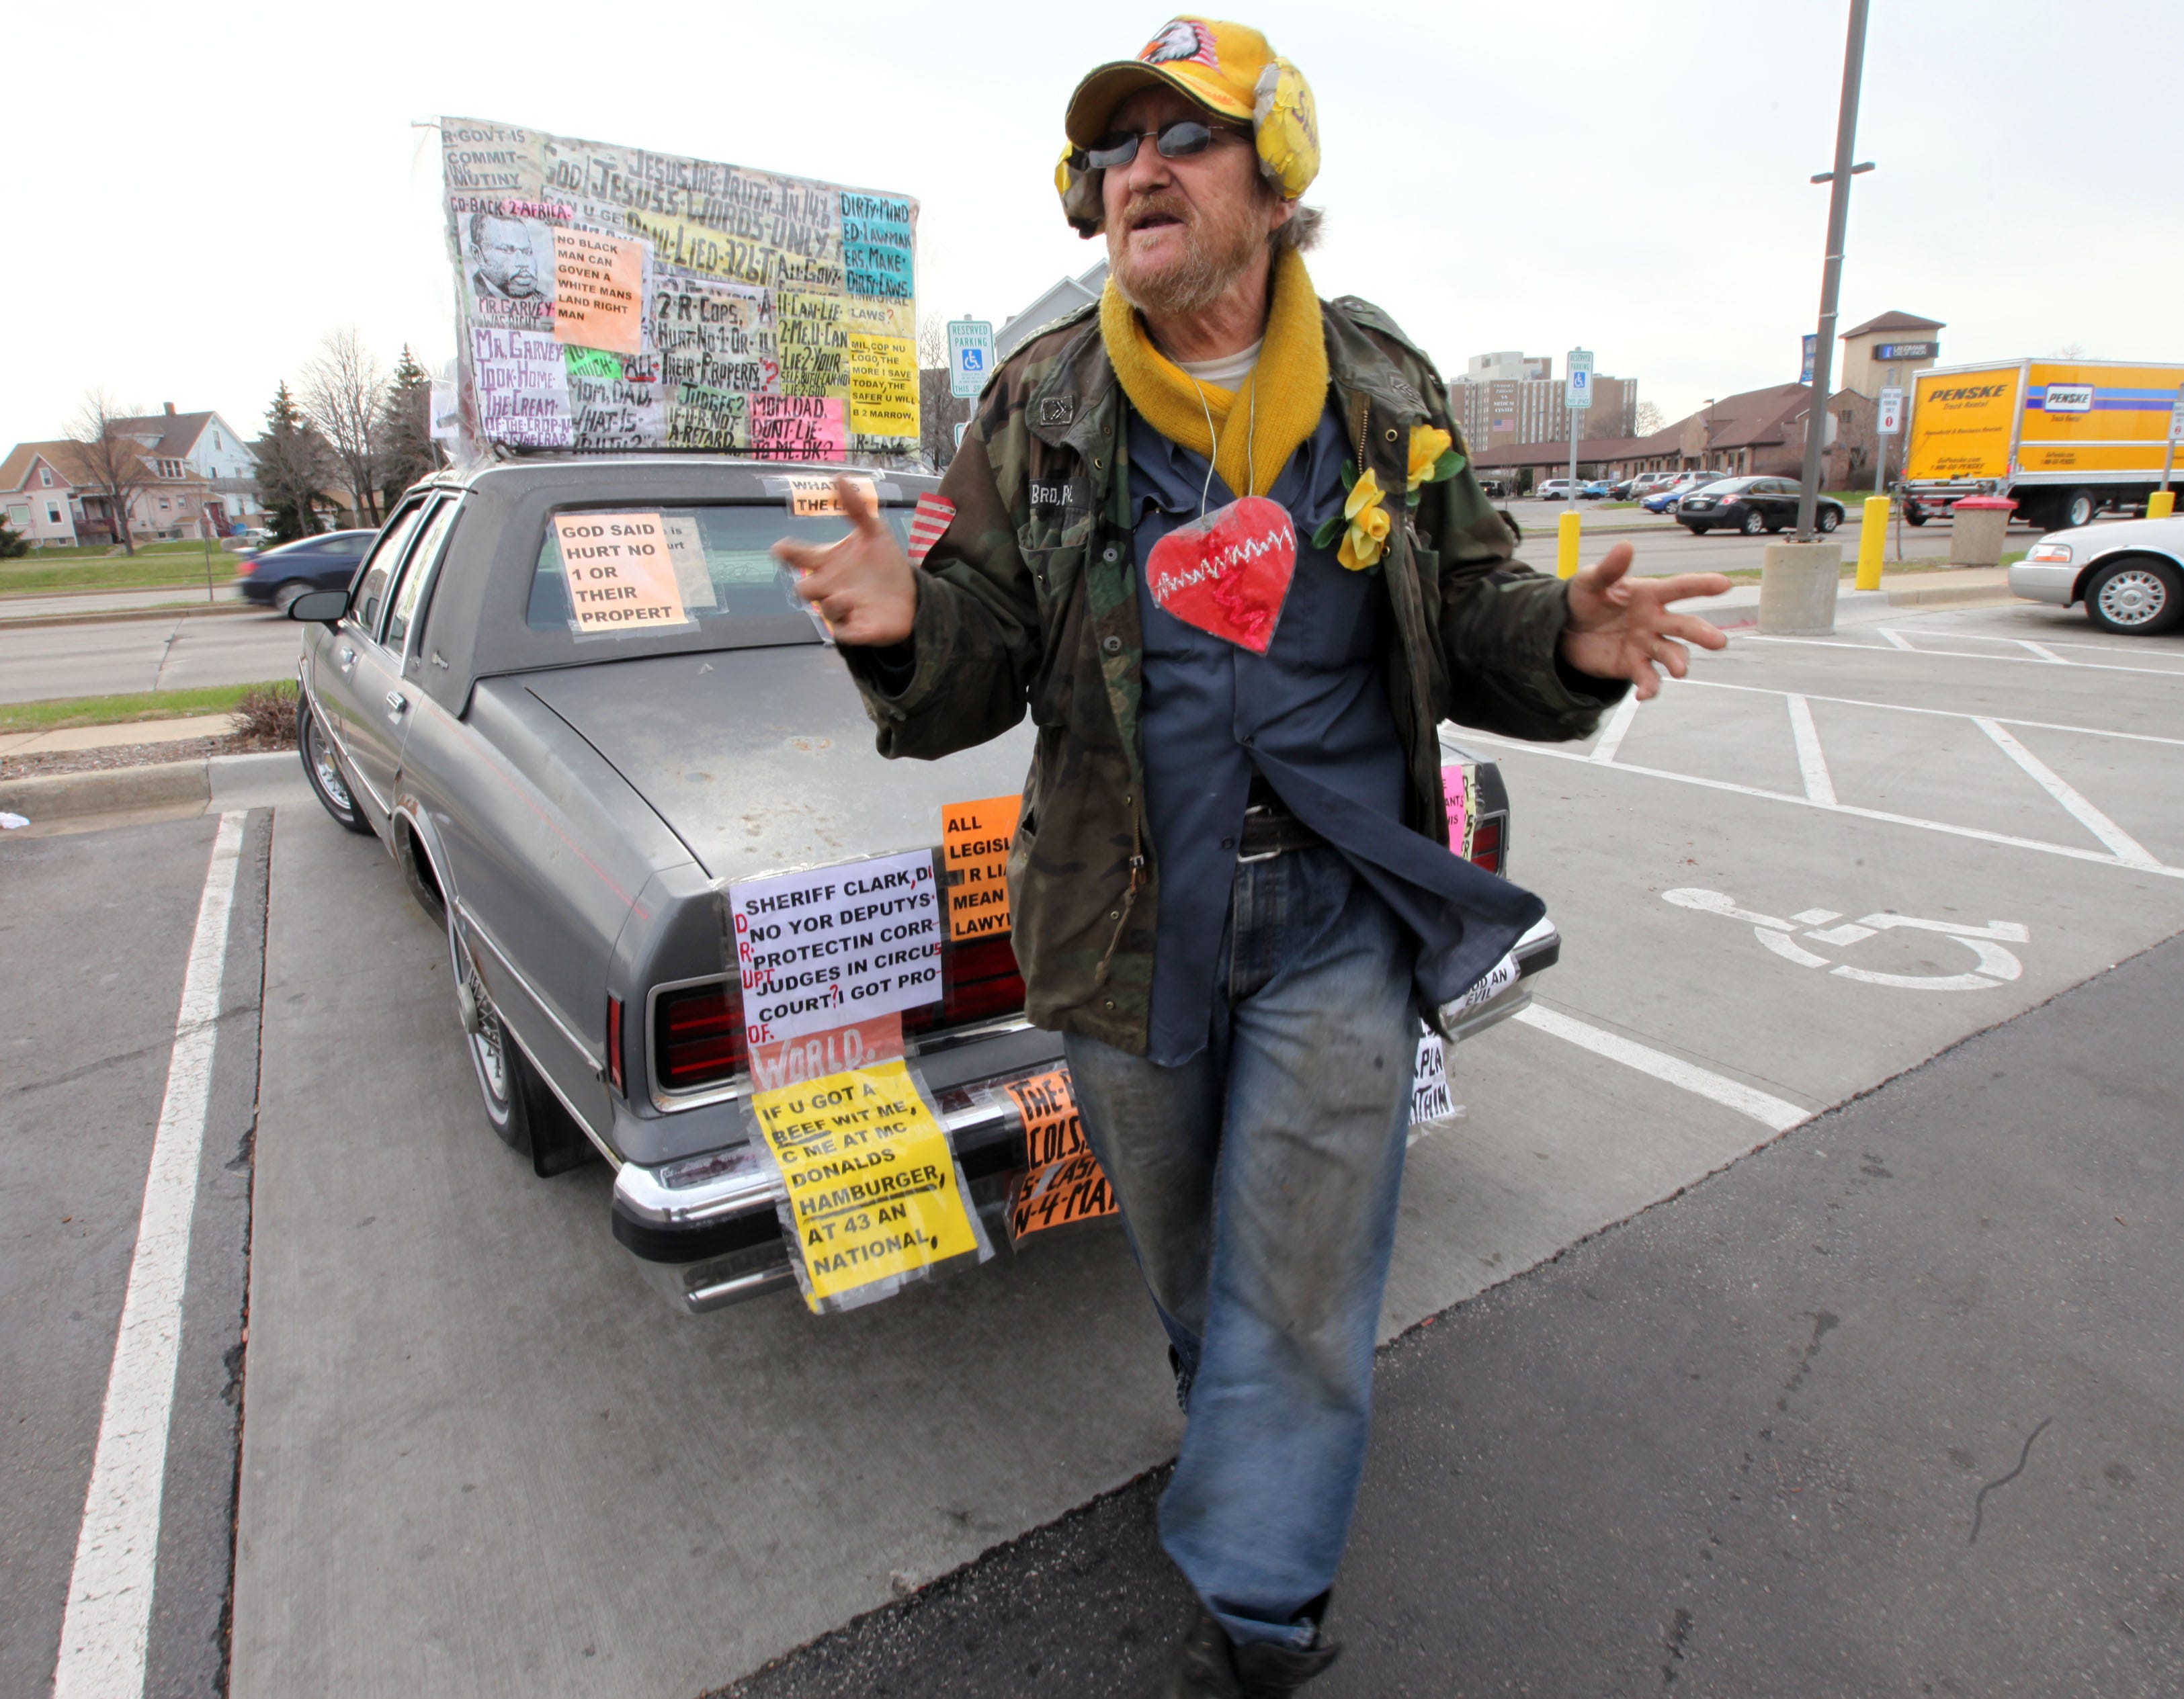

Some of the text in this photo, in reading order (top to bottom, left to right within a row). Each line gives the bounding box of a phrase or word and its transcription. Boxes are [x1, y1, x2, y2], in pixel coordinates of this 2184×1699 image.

[557, 235, 618, 255] NO BLACK
[558, 249, 613, 267] MAN CAN
[558, 264, 612, 282] GOVEN A
[558, 279, 632, 301] WHITE MANS
[558, 294, 629, 314] LAND RIGHT
[558, 309, 585, 321] MAN
[952, 325, 988, 335] RESERVED
[871, 342, 890, 351] COP
[892, 345, 906, 353] NU
[954, 337, 987, 347] PARKING
[881, 356, 899, 365] THE
[852, 366, 880, 376] MORE
[888, 369, 912, 379] SAVE
[888, 382, 905, 390] THE
[1928, 384, 2008, 402] PENSKE
[852, 392, 882, 402] SAFER
[895, 396, 916, 405] WILL
[1943, 400, 1989, 410] Truck Rental
[2048, 393, 2090, 404] PENSKE
[797, 499, 829, 511] THE
[562, 523, 655, 538] GOD SAID
[671, 526, 682, 535] is
[566, 543, 656, 560] HURT NO
[572, 566, 618, 581] 1 OR
[575, 586, 638, 603] THEIR
[581, 606, 672, 623] PROPERT
[948, 816, 982, 834] ALL
[970, 867, 982, 883] R
[745, 884, 836, 916] SHERIFF
[954, 888, 1005, 910] MEAN
[749, 892, 931, 944] NO YOR DEPUTYS
[753, 932, 874, 971] PROTECTIN
[756, 965, 841, 997] JUDGES
[848, 959, 868, 977] IN
[1491, 967, 1507, 987] AN
[850, 979, 892, 1000] GOT
[1465, 988, 1492, 1007] EVIL
[762, 1083, 877, 1122] IF U GOT A
[771, 1119, 827, 1145] BEEF
[831, 1109, 870, 1126] WIT
[782, 1121, 908, 1164] C ME AT MC
[790, 1148, 896, 1189] DONALDS
[808, 1202, 907, 1247] AT 43 AN
